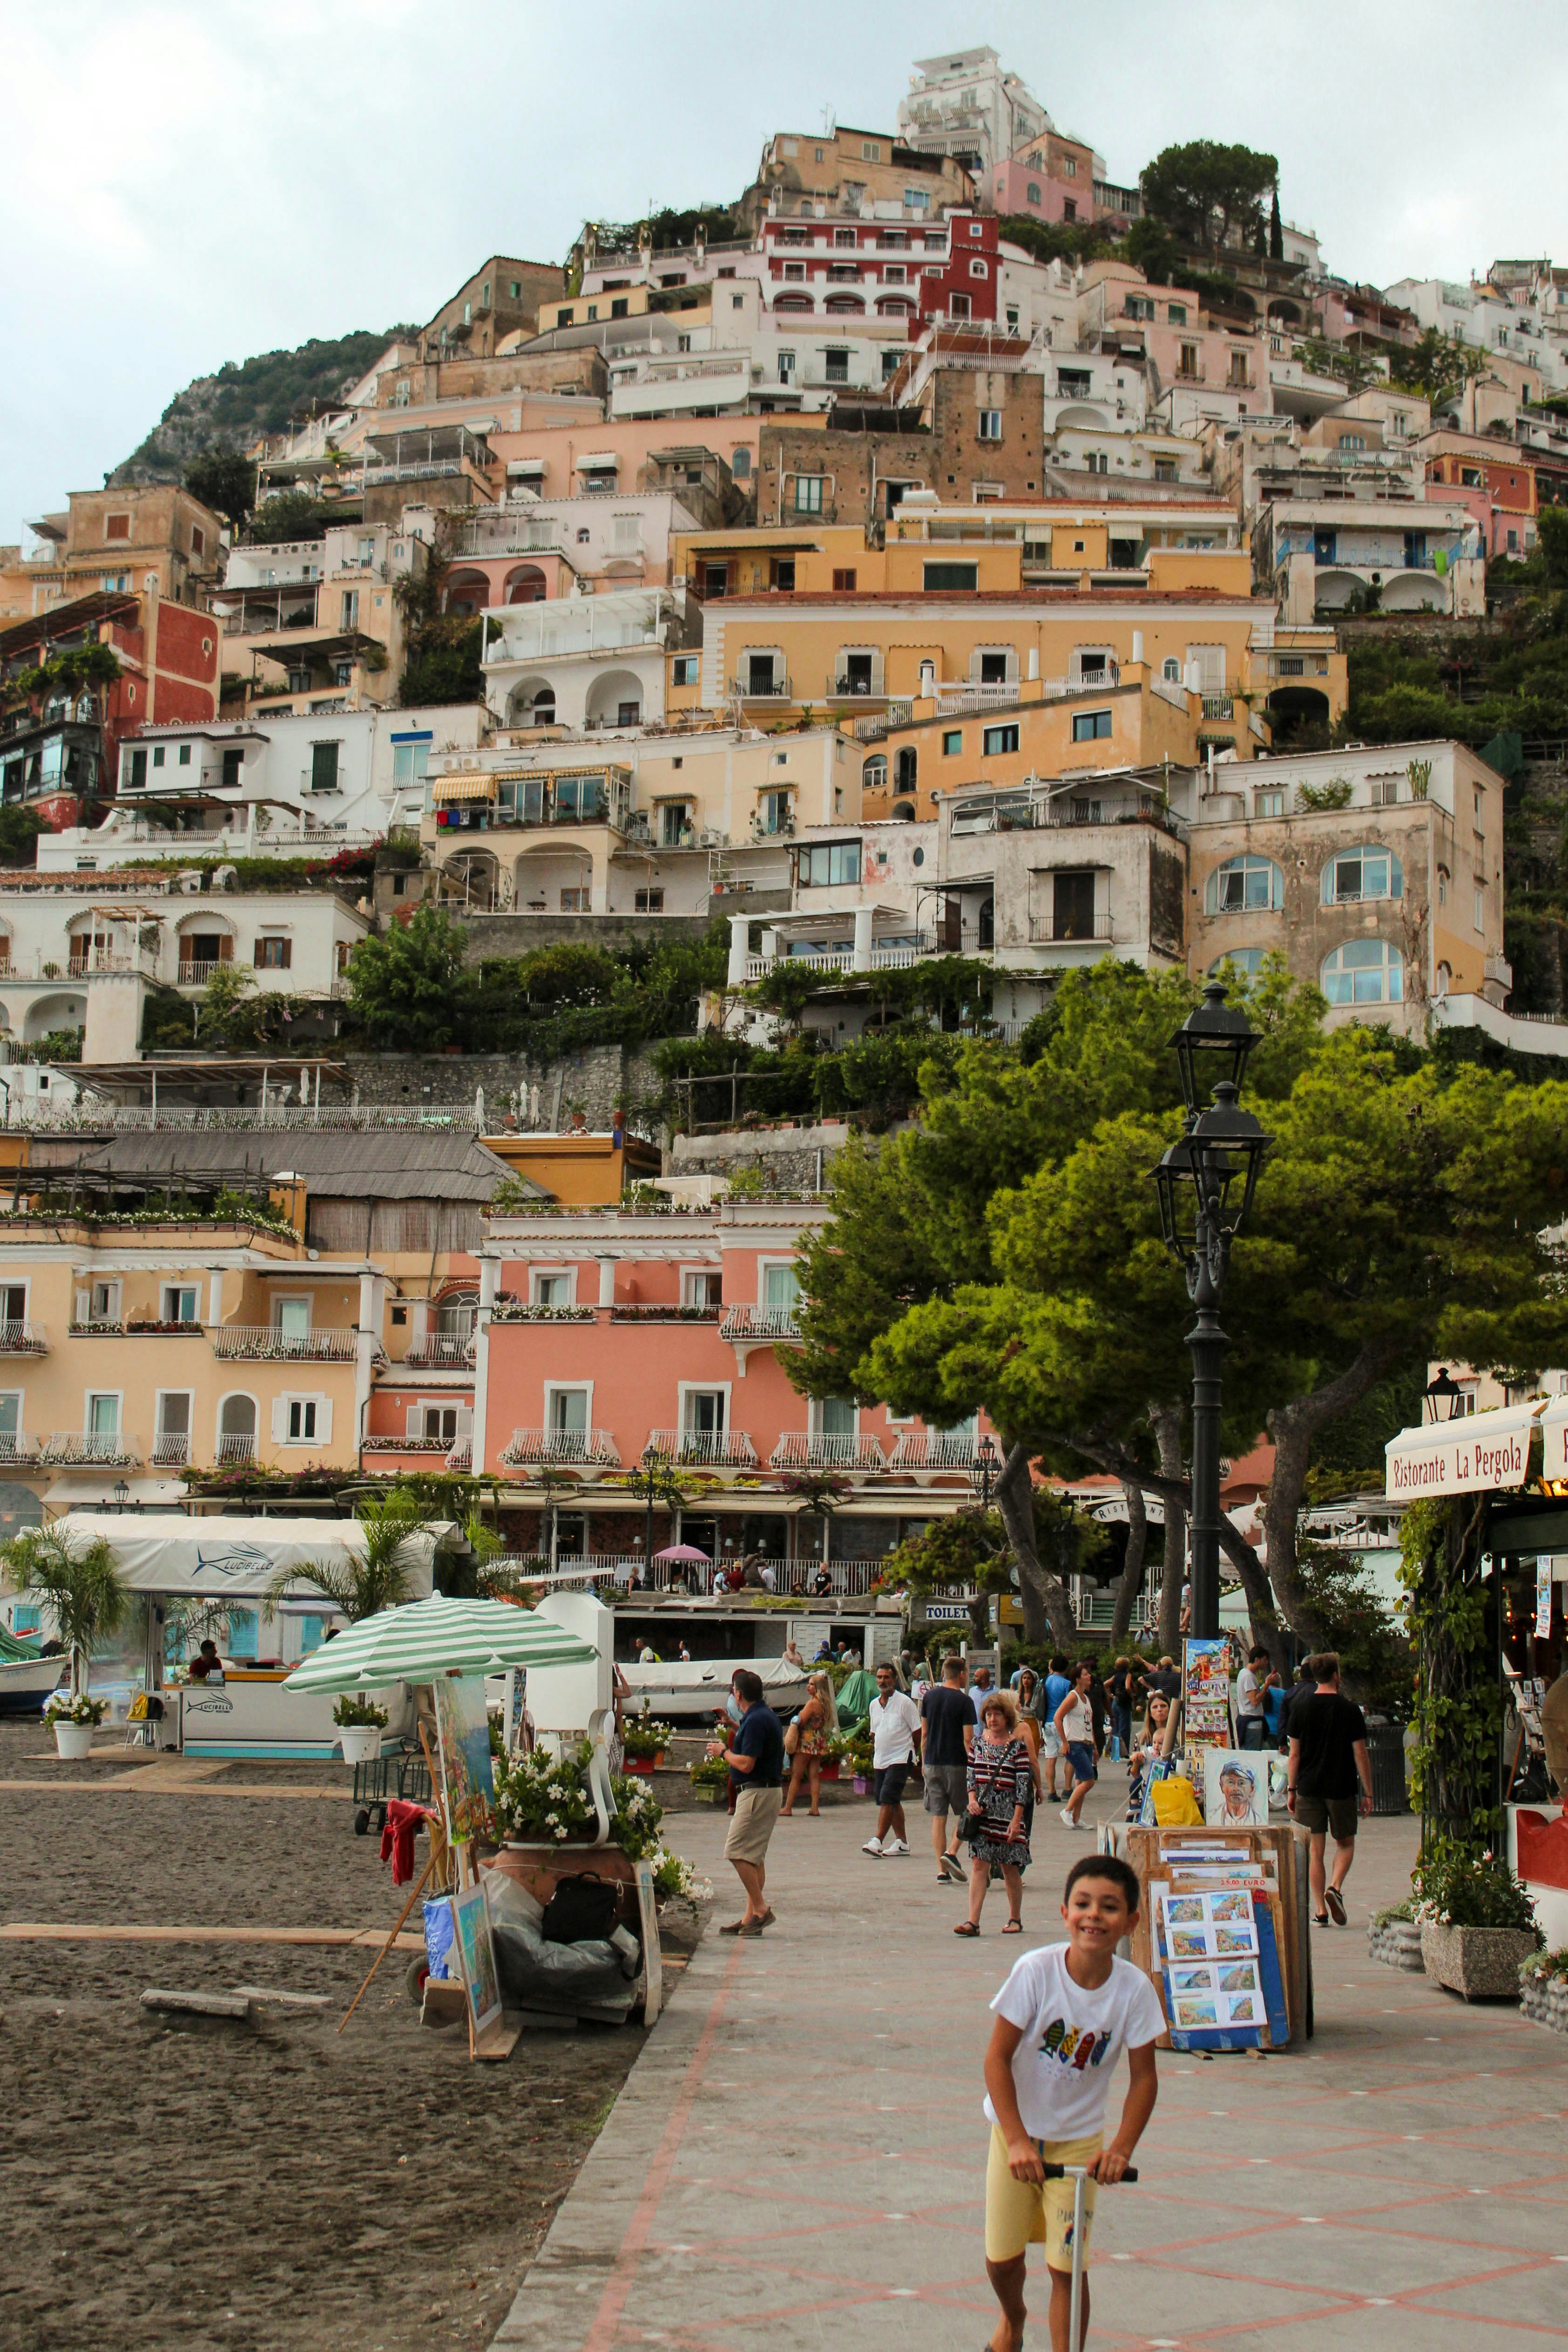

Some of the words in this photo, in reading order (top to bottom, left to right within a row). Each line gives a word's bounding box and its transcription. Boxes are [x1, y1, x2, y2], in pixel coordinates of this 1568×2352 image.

[1394, 1454, 1445, 1488] Ristorante
[1456, 1448, 1469, 1479] La
[1474, 1436, 1521, 1484] Pergola
[224, 1561, 274, 1570] LUCIBELLO
[926, 1607, 969, 1618] TOILET
